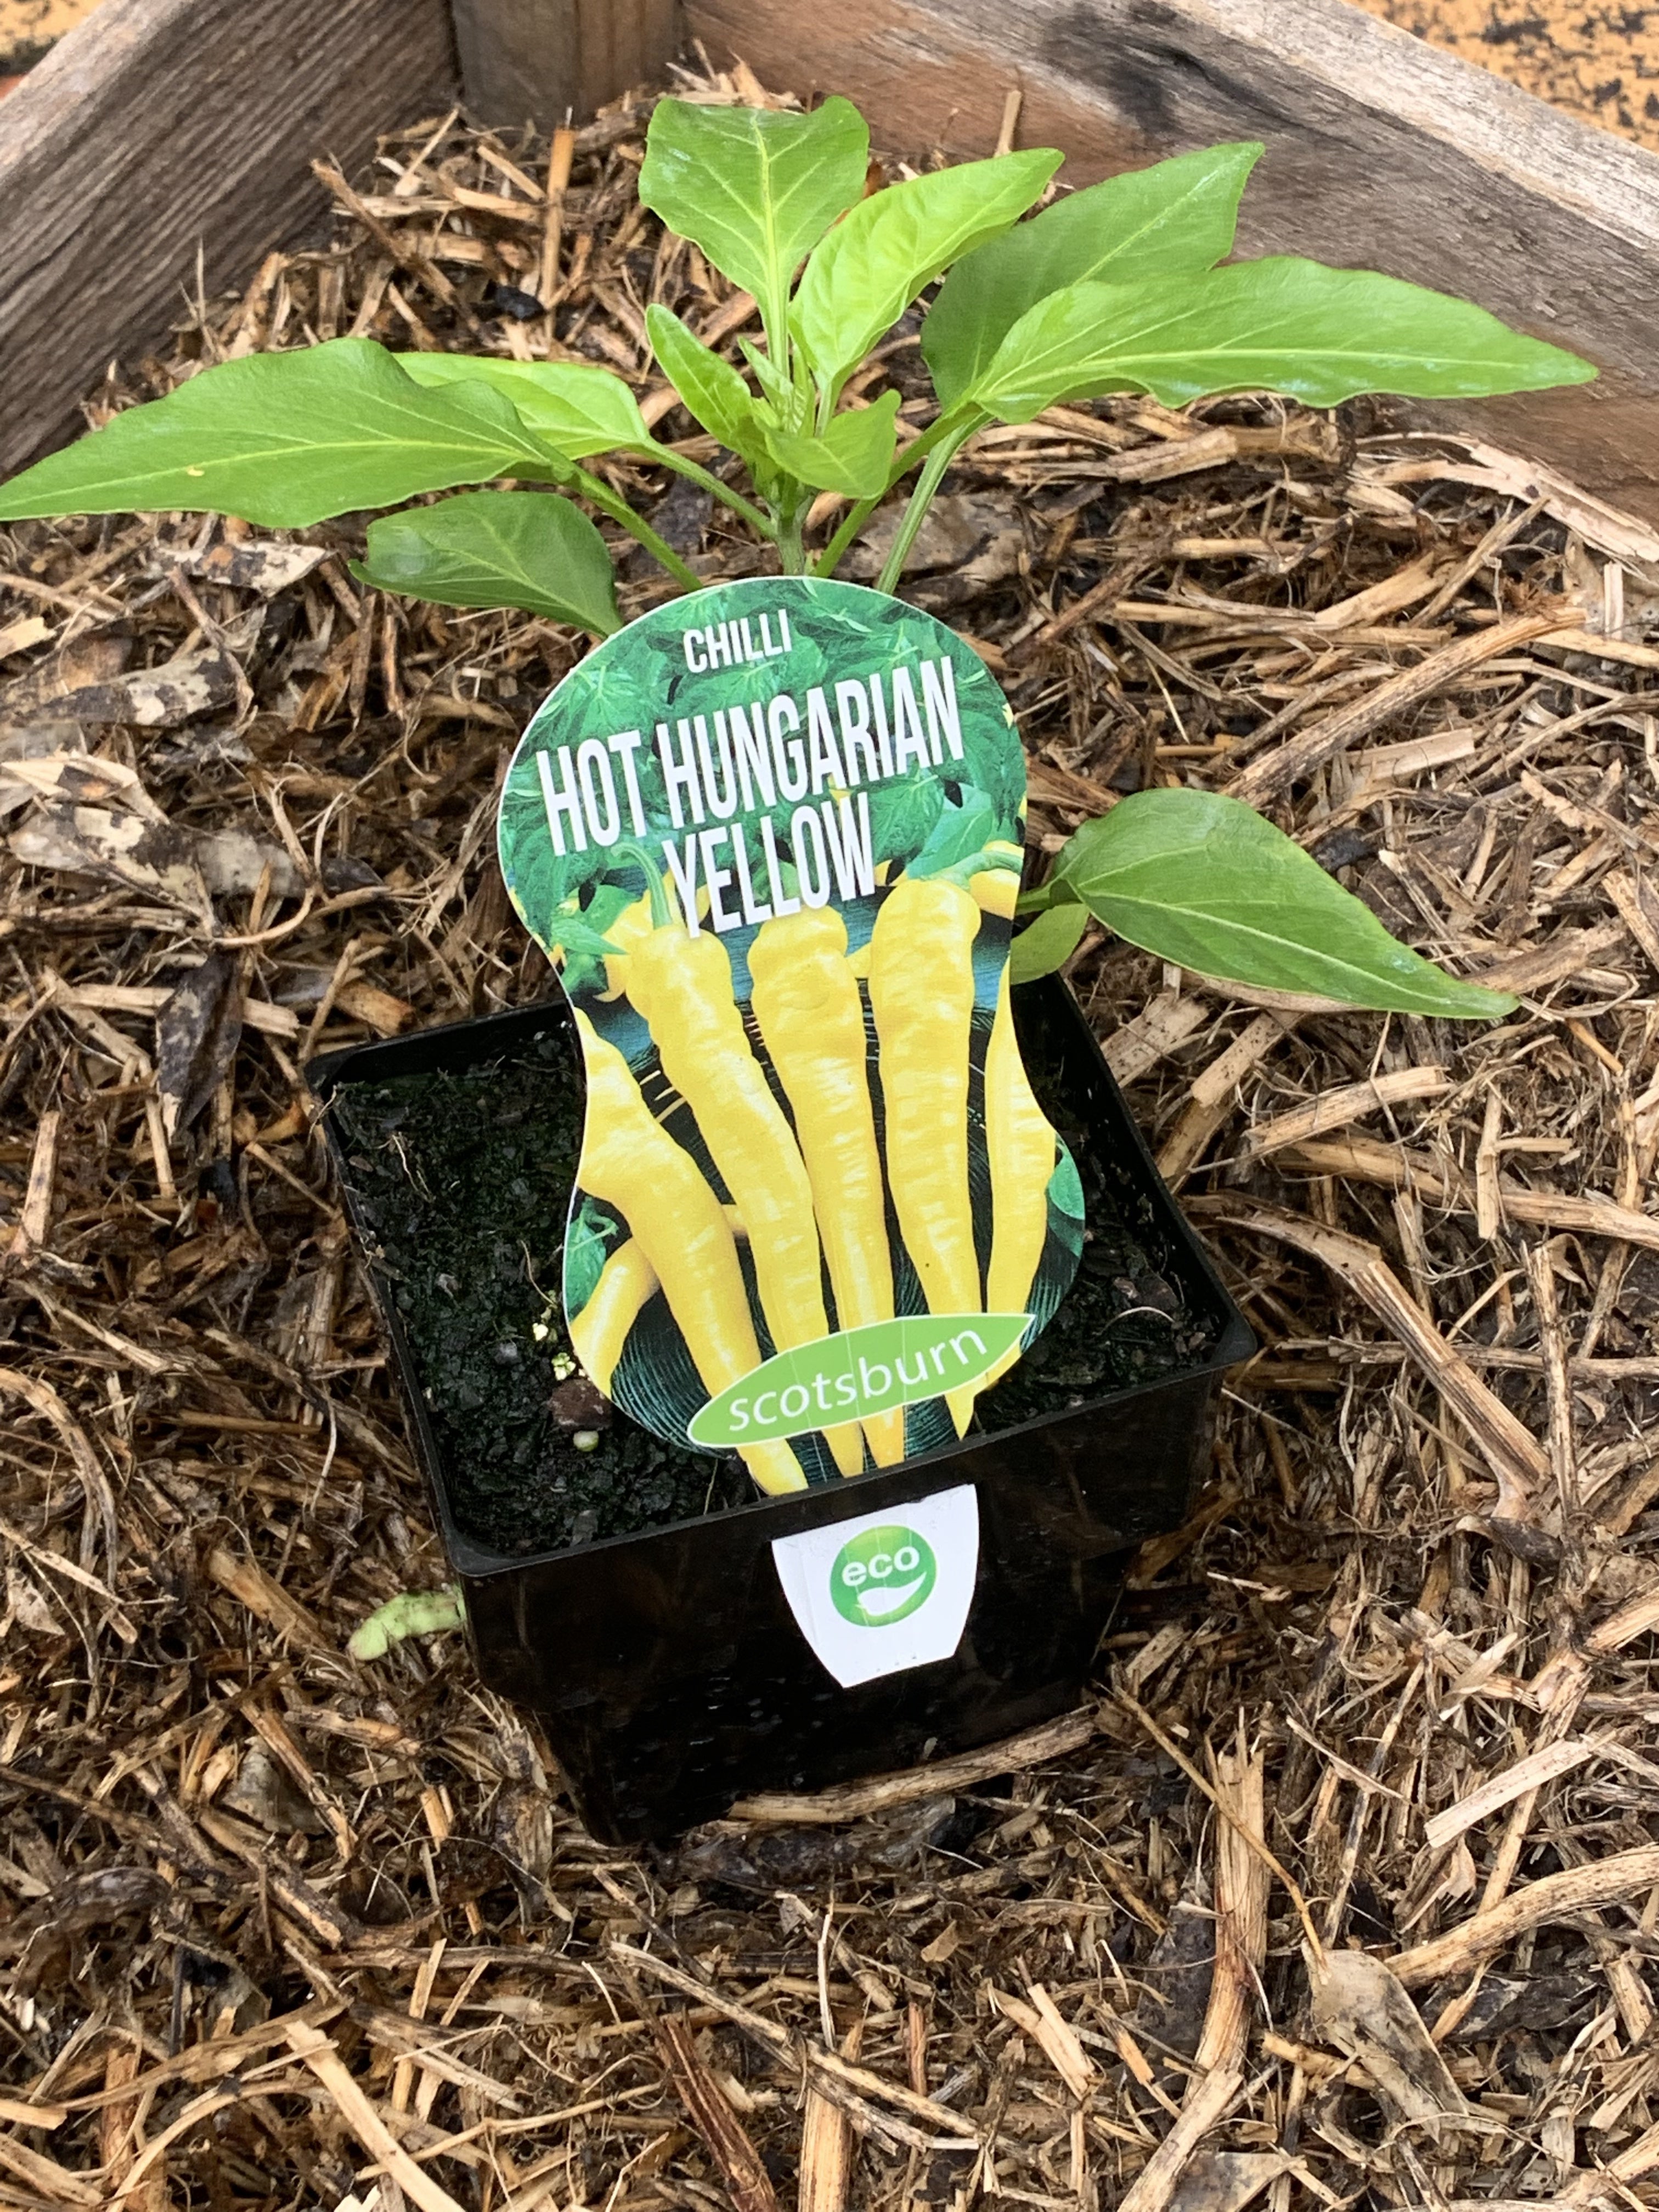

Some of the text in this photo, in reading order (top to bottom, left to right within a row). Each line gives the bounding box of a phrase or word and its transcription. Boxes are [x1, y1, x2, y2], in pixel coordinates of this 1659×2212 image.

[684, 609, 792, 673] CHILLI
[536, 656, 964, 856] HOT HUNGARIAN
[663, 792, 876, 939] YELLOW
[729, 1329, 987, 1431] scotsburn
[842, 1546, 919, 1587] eco
